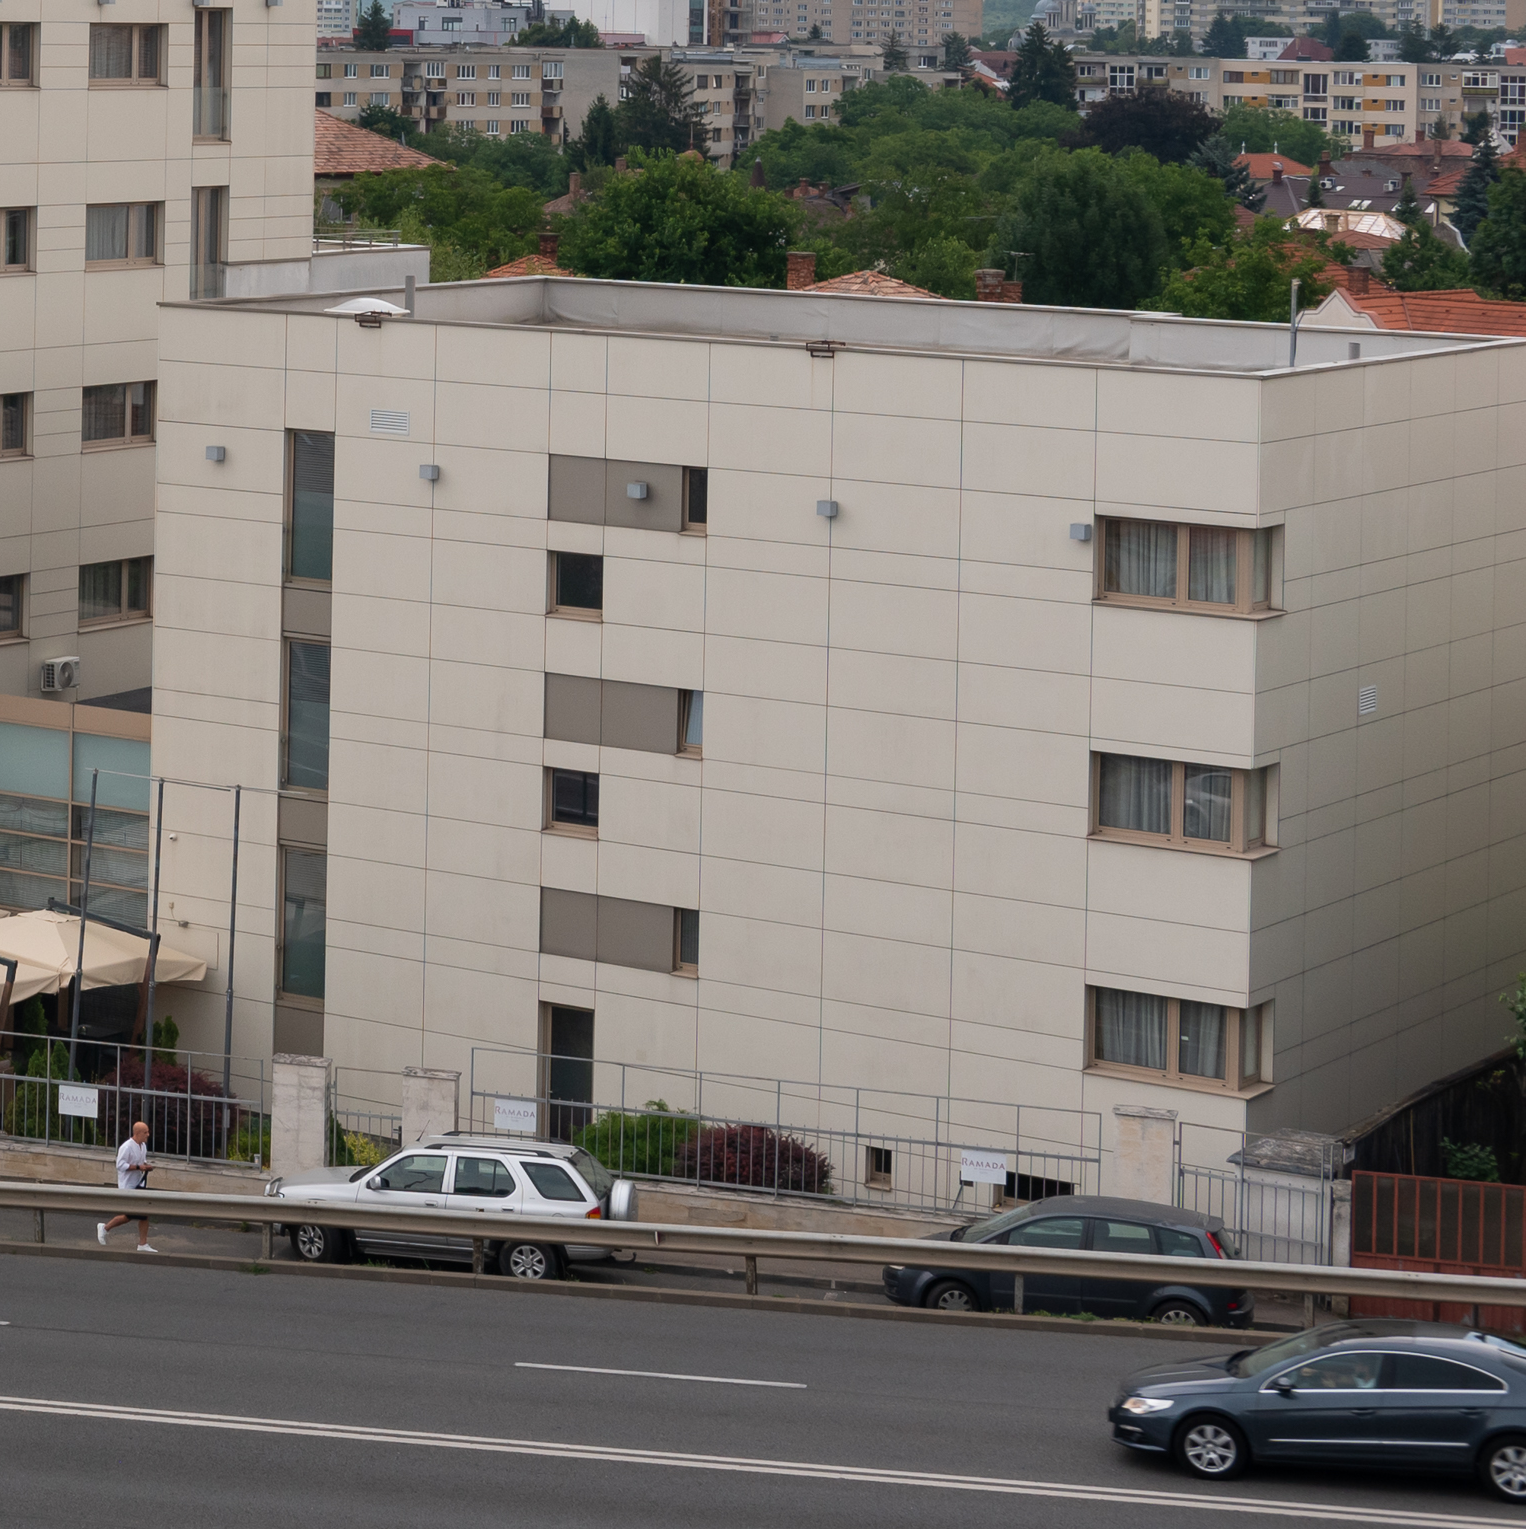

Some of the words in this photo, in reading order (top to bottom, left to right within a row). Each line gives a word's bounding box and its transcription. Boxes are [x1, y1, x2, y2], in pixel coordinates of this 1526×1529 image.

[59, 1092, 97, 1104] RAMADA
[494, 1105, 536, 1118] RAMADA
[961, 1157, 1006, 1170] RAMADA
